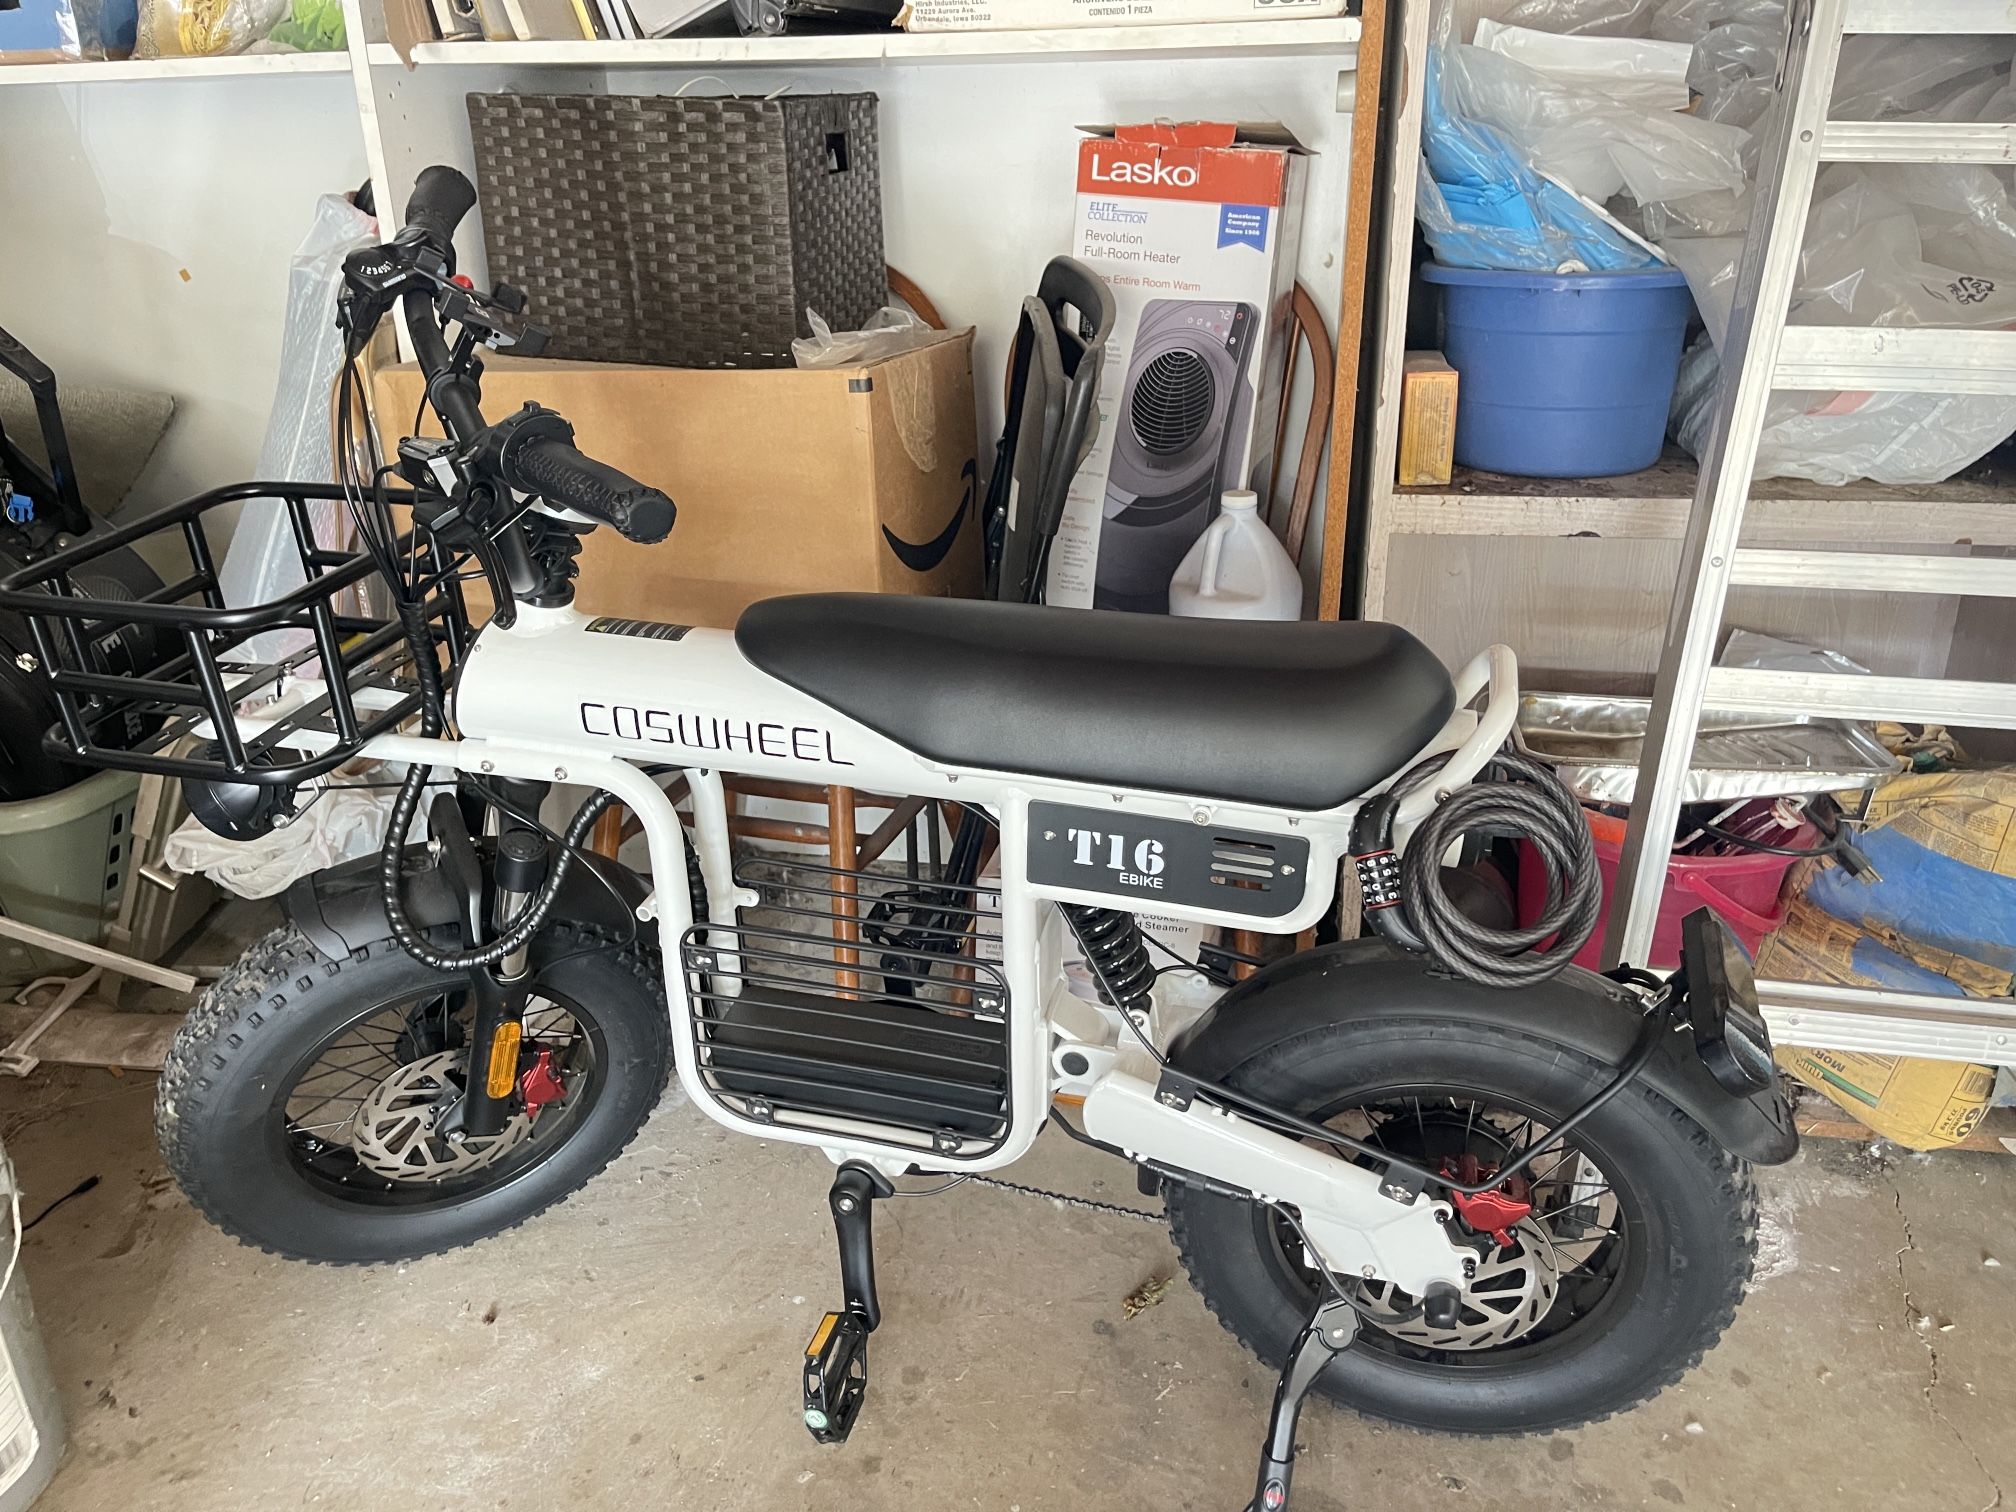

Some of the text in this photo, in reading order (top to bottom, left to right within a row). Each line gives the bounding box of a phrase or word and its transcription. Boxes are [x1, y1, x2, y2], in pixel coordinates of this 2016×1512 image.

[1088, 4, 1153, 16] CONTENIDO 1 PIEZA
[1091, 153, 1197, 187] Lasko
[1089, 202, 1119, 212] ELITE
[1087, 211, 1148, 225] COLLECTION
[1085, 229, 1143, 245] Revolution
[1083, 246, 1181, 264] Full-Room Heater
[1113, 274, 1140, 286] Entire
[1142, 278, 1171, 289] Room
[1173, 280, 1201, 292] Warm
[580, 702, 855, 767] COSWHEEL
[1068, 828, 1165, 875] T16
[1119, 872, 1164, 889] EBIKE
[1144, 921, 1189, 933] Steamer
